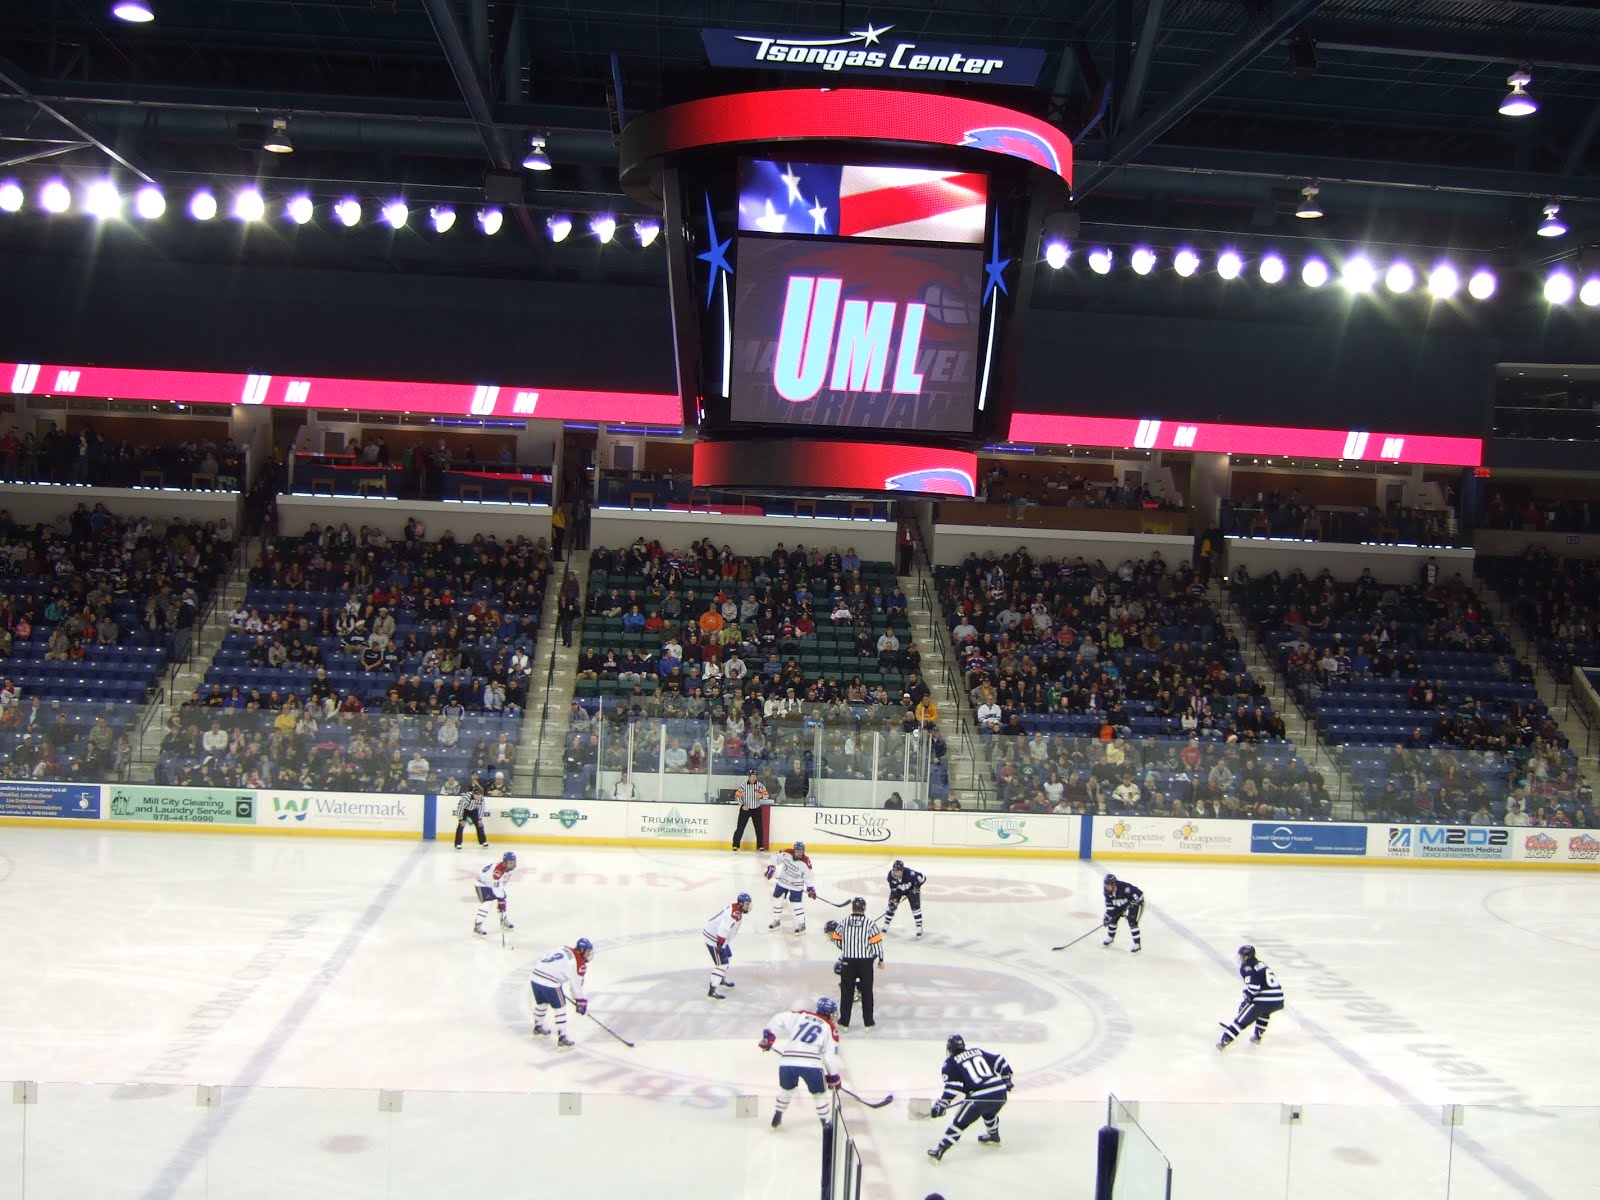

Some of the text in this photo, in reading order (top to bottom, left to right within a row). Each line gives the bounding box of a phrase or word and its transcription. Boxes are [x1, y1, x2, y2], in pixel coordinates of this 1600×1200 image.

[756, 38, 1003, 74] Tsongas Center
[773, 276, 927, 402] UML
[135, 805, 232, 816] and Laundry Service
[143, 797, 224, 808] Mill City Cleaning
[316, 799, 407, 816] Watermark
[641, 815, 709, 825] TRIUMVIRATE
[859, 826, 883, 837] EMS
[1419, 827, 1509, 846] M2D2
[1423, 845, 1474, 853] Massachusetts
[1525, 849, 1556, 859] LIGHT
[1266, 968, 1280, 988] 6
[792, 1021, 822, 1044] 16
[962, 1055, 994, 1084] 10
